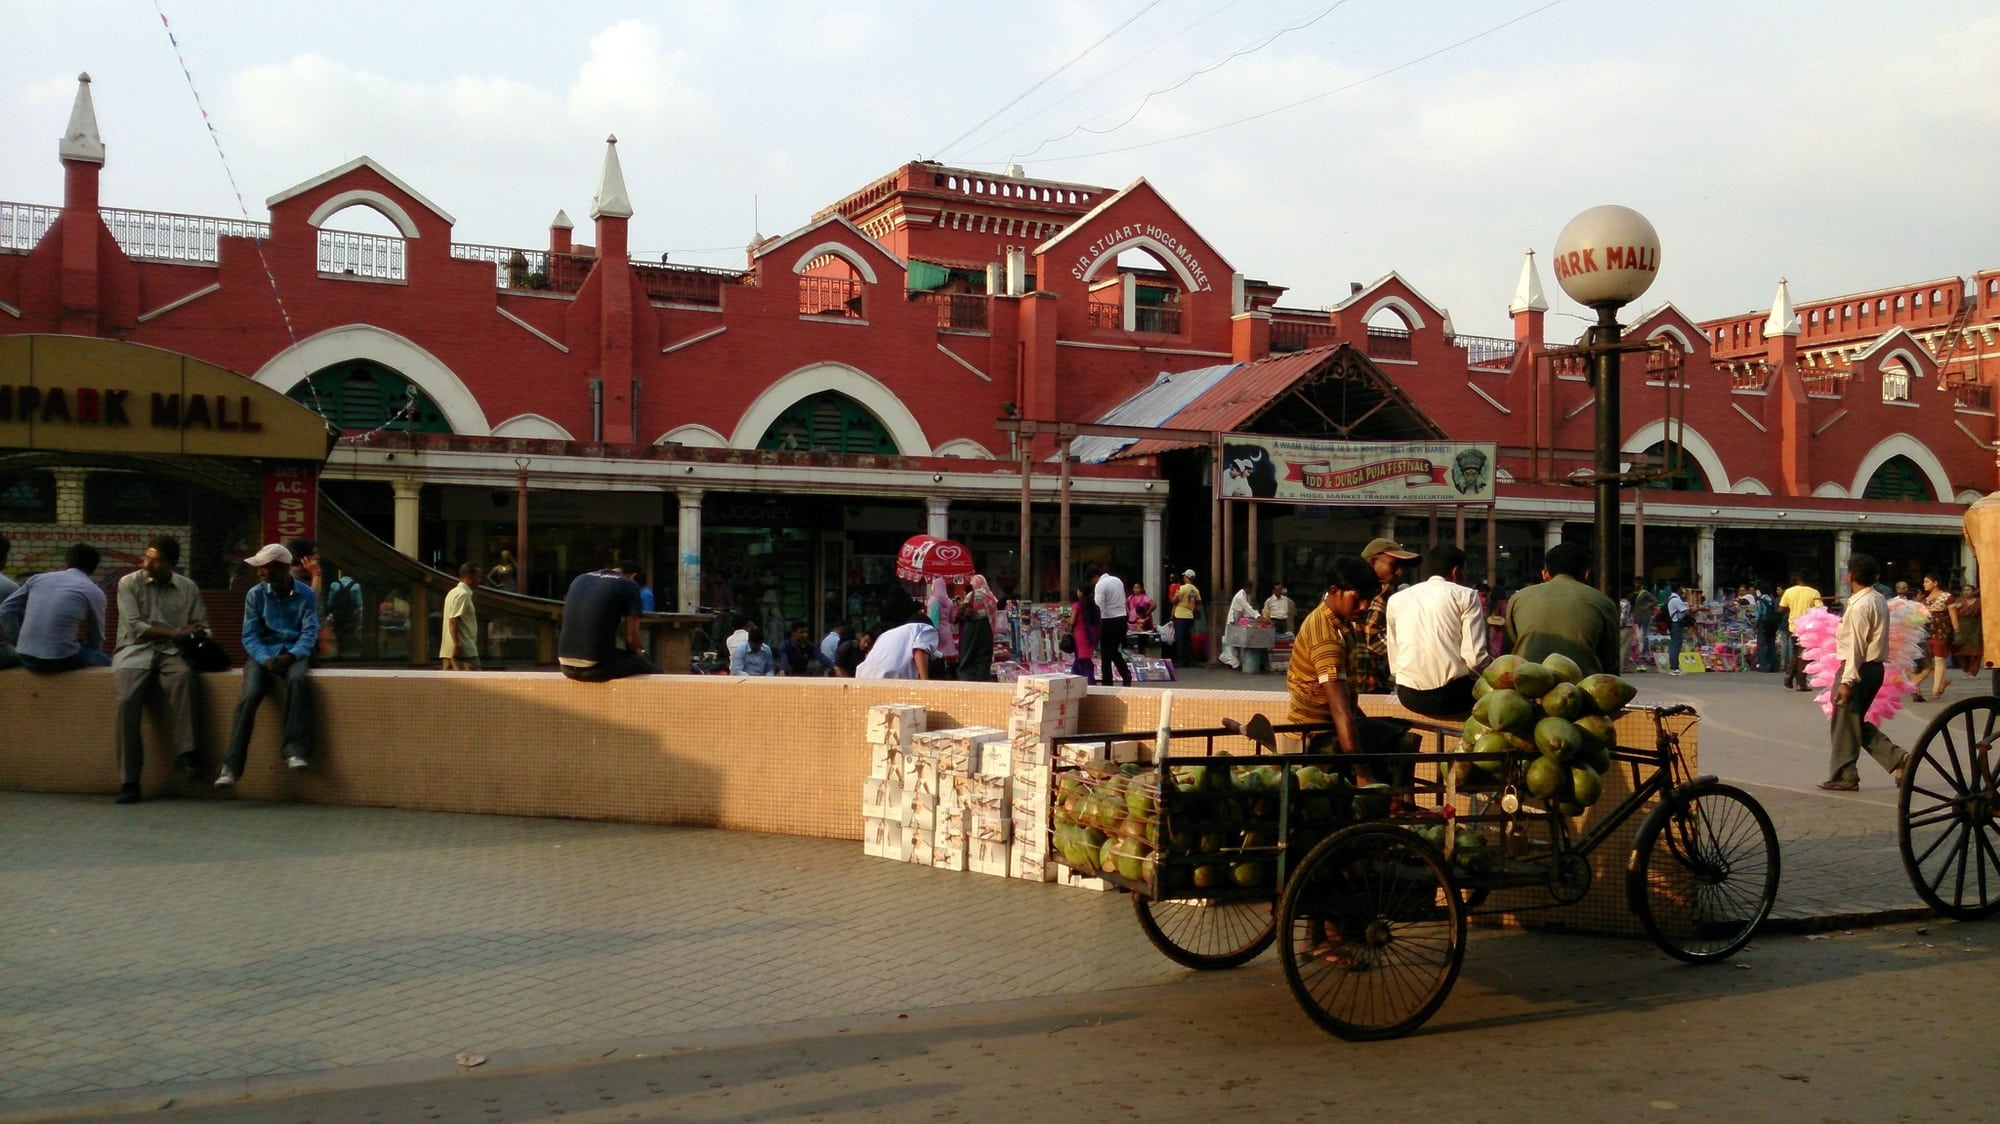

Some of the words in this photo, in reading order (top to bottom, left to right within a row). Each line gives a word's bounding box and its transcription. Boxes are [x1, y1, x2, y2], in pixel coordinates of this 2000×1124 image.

[1071, 256, 1091, 280] SIR
[1089, 223, 1142, 257] STUART
[1146, 224, 1177, 250] HOGG
[1175, 243, 1212, 292] MARKET
[1605, 245, 1656, 273] MALL
[151, 391, 264, 433] MALL
[275, 481, 307, 494] A.C.
[1306, 474, 1323, 488] IDD
[1325, 475, 1333, 488] &
[1335, 469, 1365, 487] DURGA
[1366, 464, 1386, 480] PUJA
[1387, 461, 1430, 475] FESTIVALS
